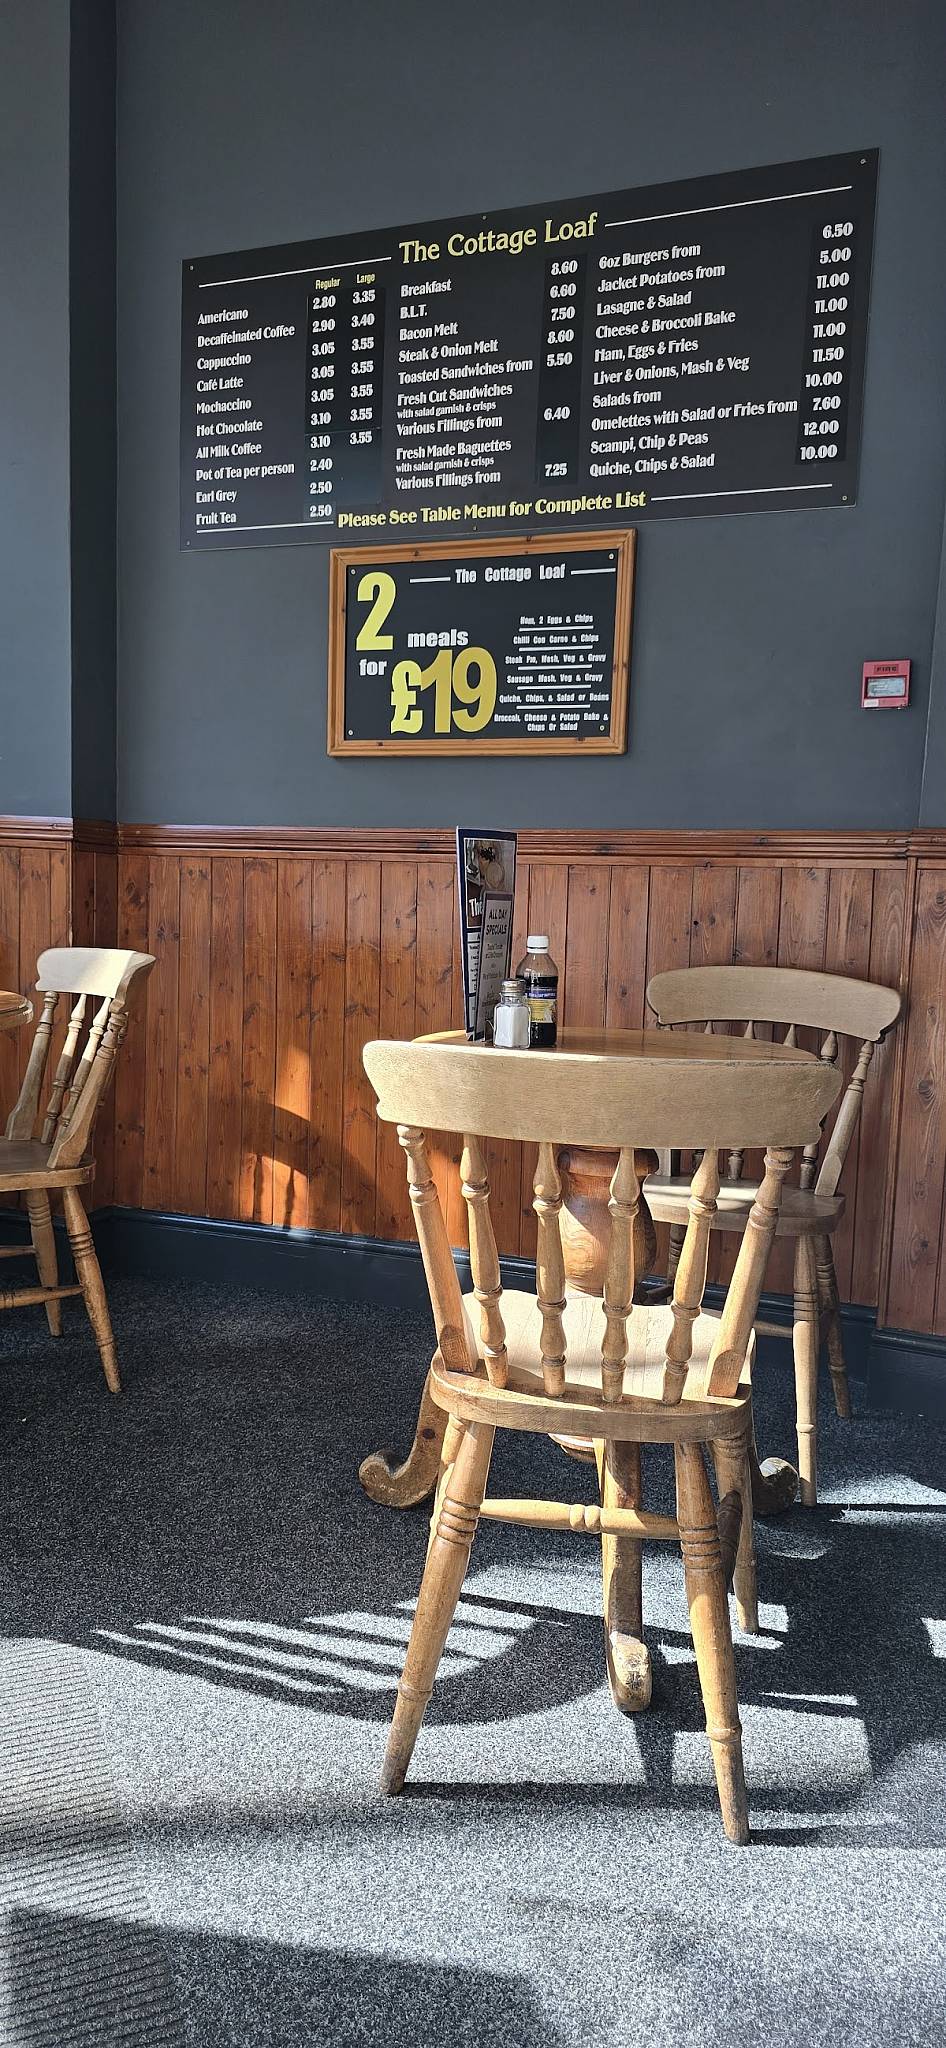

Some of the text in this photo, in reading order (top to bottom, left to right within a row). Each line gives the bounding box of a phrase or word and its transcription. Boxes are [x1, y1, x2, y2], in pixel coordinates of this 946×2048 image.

[399, 212, 597, 263] The Cottage Loaf
[823, 222, 853, 238] 6.50
[599, 245, 700, 269] 6oz Burgers from
[820, 248, 851, 264] 5.00
[551, 260, 578, 275] 8.60
[316, 278, 340, 290] Regular
[357, 274, 375, 284] Large
[598, 266, 725, 292] Jacket Potatoes from
[817, 272, 849, 288] 11.00
[401, 279, 451, 297] Breakfast
[550, 283, 576, 298] 6.60
[313, 295, 336, 309] 2.80
[353, 290, 375, 304] 3.35
[597, 291, 692, 315] Lasagne & Salad
[400, 304, 427, 318] B.L.T.
[815, 298, 847, 313] 11.00
[198, 310, 248, 324] Americano
[352, 313, 374, 327] 3.40
[551, 306, 575, 321] 7.50
[313, 319, 335, 332] 2.90
[400, 322, 458, 340] Bacon Melt
[596, 311, 735, 338] Cheese & Broccoli Bake
[813, 322, 846, 338] 11.00
[198, 325, 294, 347] Decaffeinated Coffee
[352, 337, 374, 350] 3.55
[548, 329, 574, 344] 8.60
[312, 342, 335, 356] 3.05
[399, 340, 498, 362] Steak & Onion Melt
[595, 338, 698, 362] Ham, Eggs & Fries
[813, 347, 844, 362] 11.50
[197, 353, 251, 370] Cappuccino
[547, 352, 572, 366] 5.50
[312, 365, 334, 379] 3.05
[351, 360, 373, 374] 3.55
[398, 360, 532, 384] Toasted Sandwiches from
[594, 357, 750, 385] Liver & Onions, Mash & Veg
[197, 377, 243, 392] Café Latte
[806, 372, 842, 387] 10.00
[311, 388, 334, 402] 3.05
[351, 384, 373, 397] 3.55
[398, 384, 512, 406] Fresh Cut Sandwiches
[197, 398, 251, 414] Mochaccino
[593, 391, 661, 408] Salads from
[813, 396, 840, 410] 7.60
[350, 408, 372, 421] 3.55
[397, 402, 496, 418] with salad garnish & crisps
[544, 407, 570, 420] 6.40
[592, 401, 797, 430] Omelettes with Salad or Fries from
[311, 412, 331, 425] 3.10
[397, 416, 502, 436] Various Fillings from
[197, 420, 262, 436] Hot Chocolate
[804, 420, 839, 435] 12.00
[311, 436, 330, 448] 3.10
[350, 431, 372, 444] 3.55
[591, 433, 708, 454] Scampi, Chip & Peas
[196, 443, 262, 458] All Milk Coffee
[397, 440, 511, 460] Fresh Made Baguettes
[800, 444, 837, 460] 10.00
[310, 458, 332, 471] 2.40
[545, 463, 567, 476] 7.25
[590, 454, 714, 477] Quiche, Chips & Salad
[196, 464, 294, 481] Pot of Tea per person
[310, 481, 332, 494] 2.50
[396, 472, 500, 489] Various Fillings from
[196, 490, 236, 503] Earl Grey
[310, 504, 332, 517] 2.50
[338, 492, 646, 528] Please See Table Menu for Complete List
[196, 512, 236, 525] Fruit Tea
[456, 564, 565, 583] The Cottage Loaf
[356, 572, 469, 651] 2 meals
[539, 616, 543, 624] 2
[547, 616, 562, 624] Eggs
[575, 614, 593, 623] Chips
[360, 647, 497, 734] for £19
